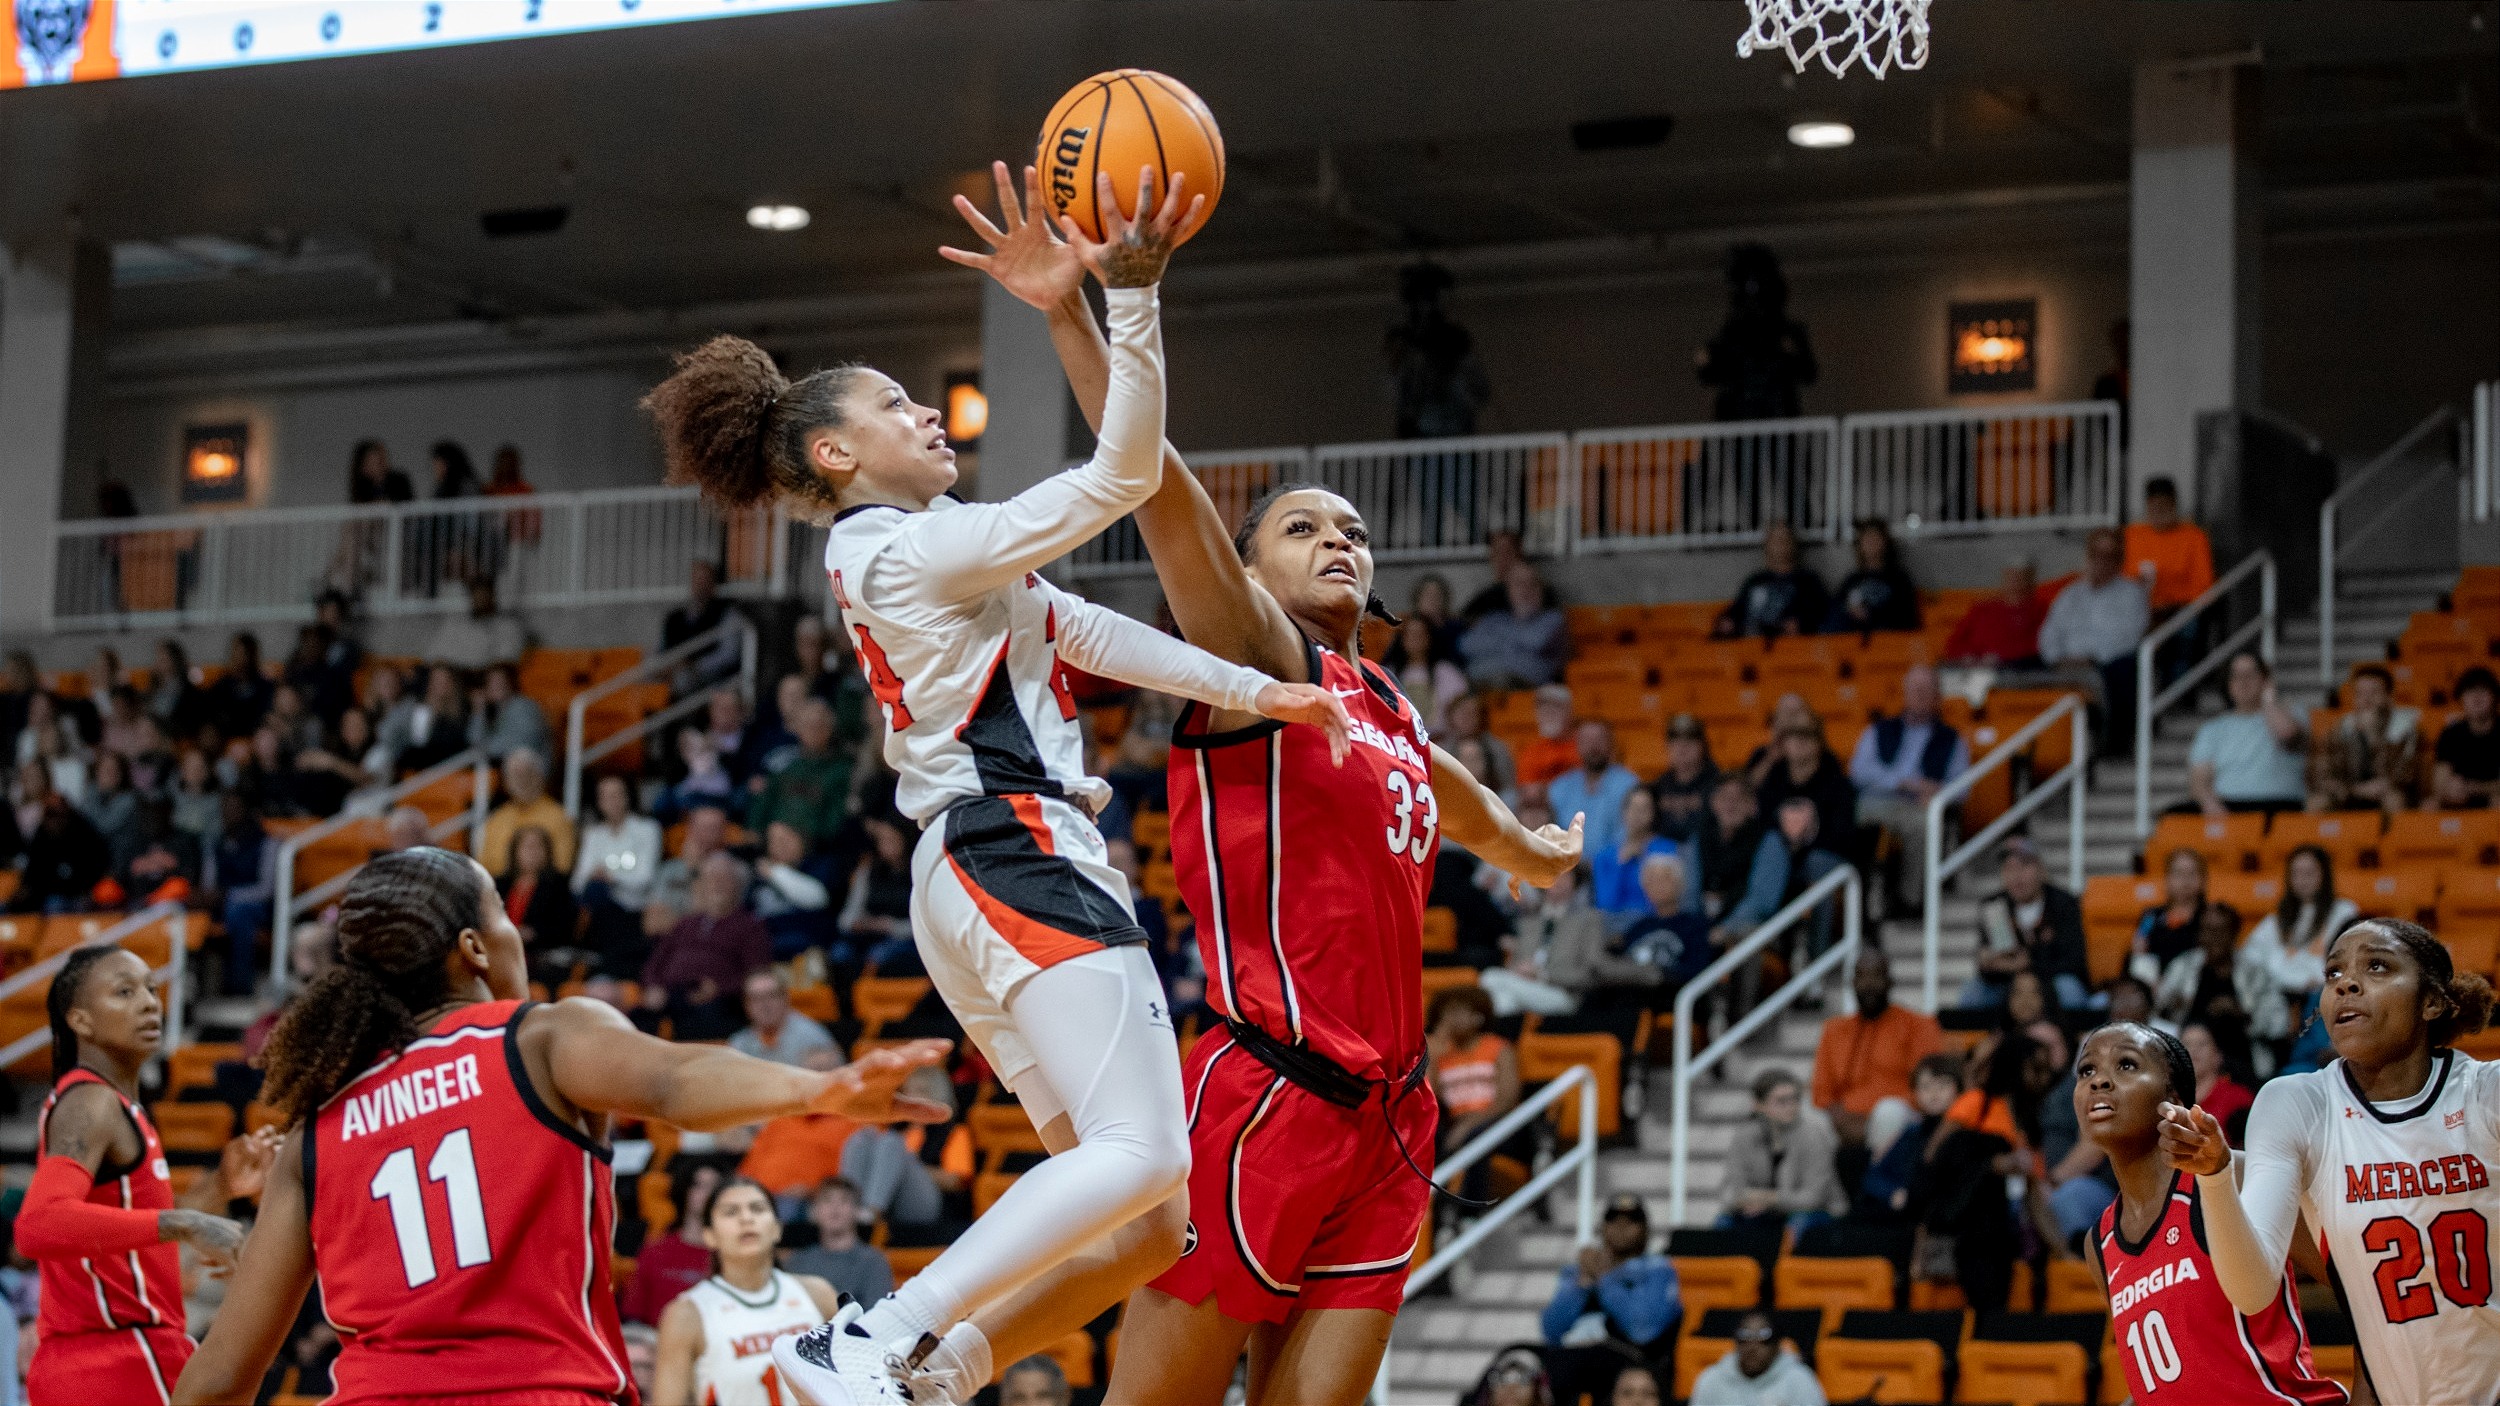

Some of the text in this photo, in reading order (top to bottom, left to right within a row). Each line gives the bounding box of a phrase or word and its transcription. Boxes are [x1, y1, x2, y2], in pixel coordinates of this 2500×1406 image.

[158, 29, 178, 59] 0
[236, 22, 255, 51] 0
[321, 13, 342, 42] 0
[1052, 127, 1091, 216] Wils
[855, 623, 915, 732] 4
[1386, 770, 1438, 865] 33
[341, 1053, 483, 1142] AVINGER
[370, 1127, 492, 1289] 11
[2345, 1153, 2489, 1204] MERCER
[2361, 1207, 2493, 1324] 20
[2126, 1309, 2182, 1394] 10
